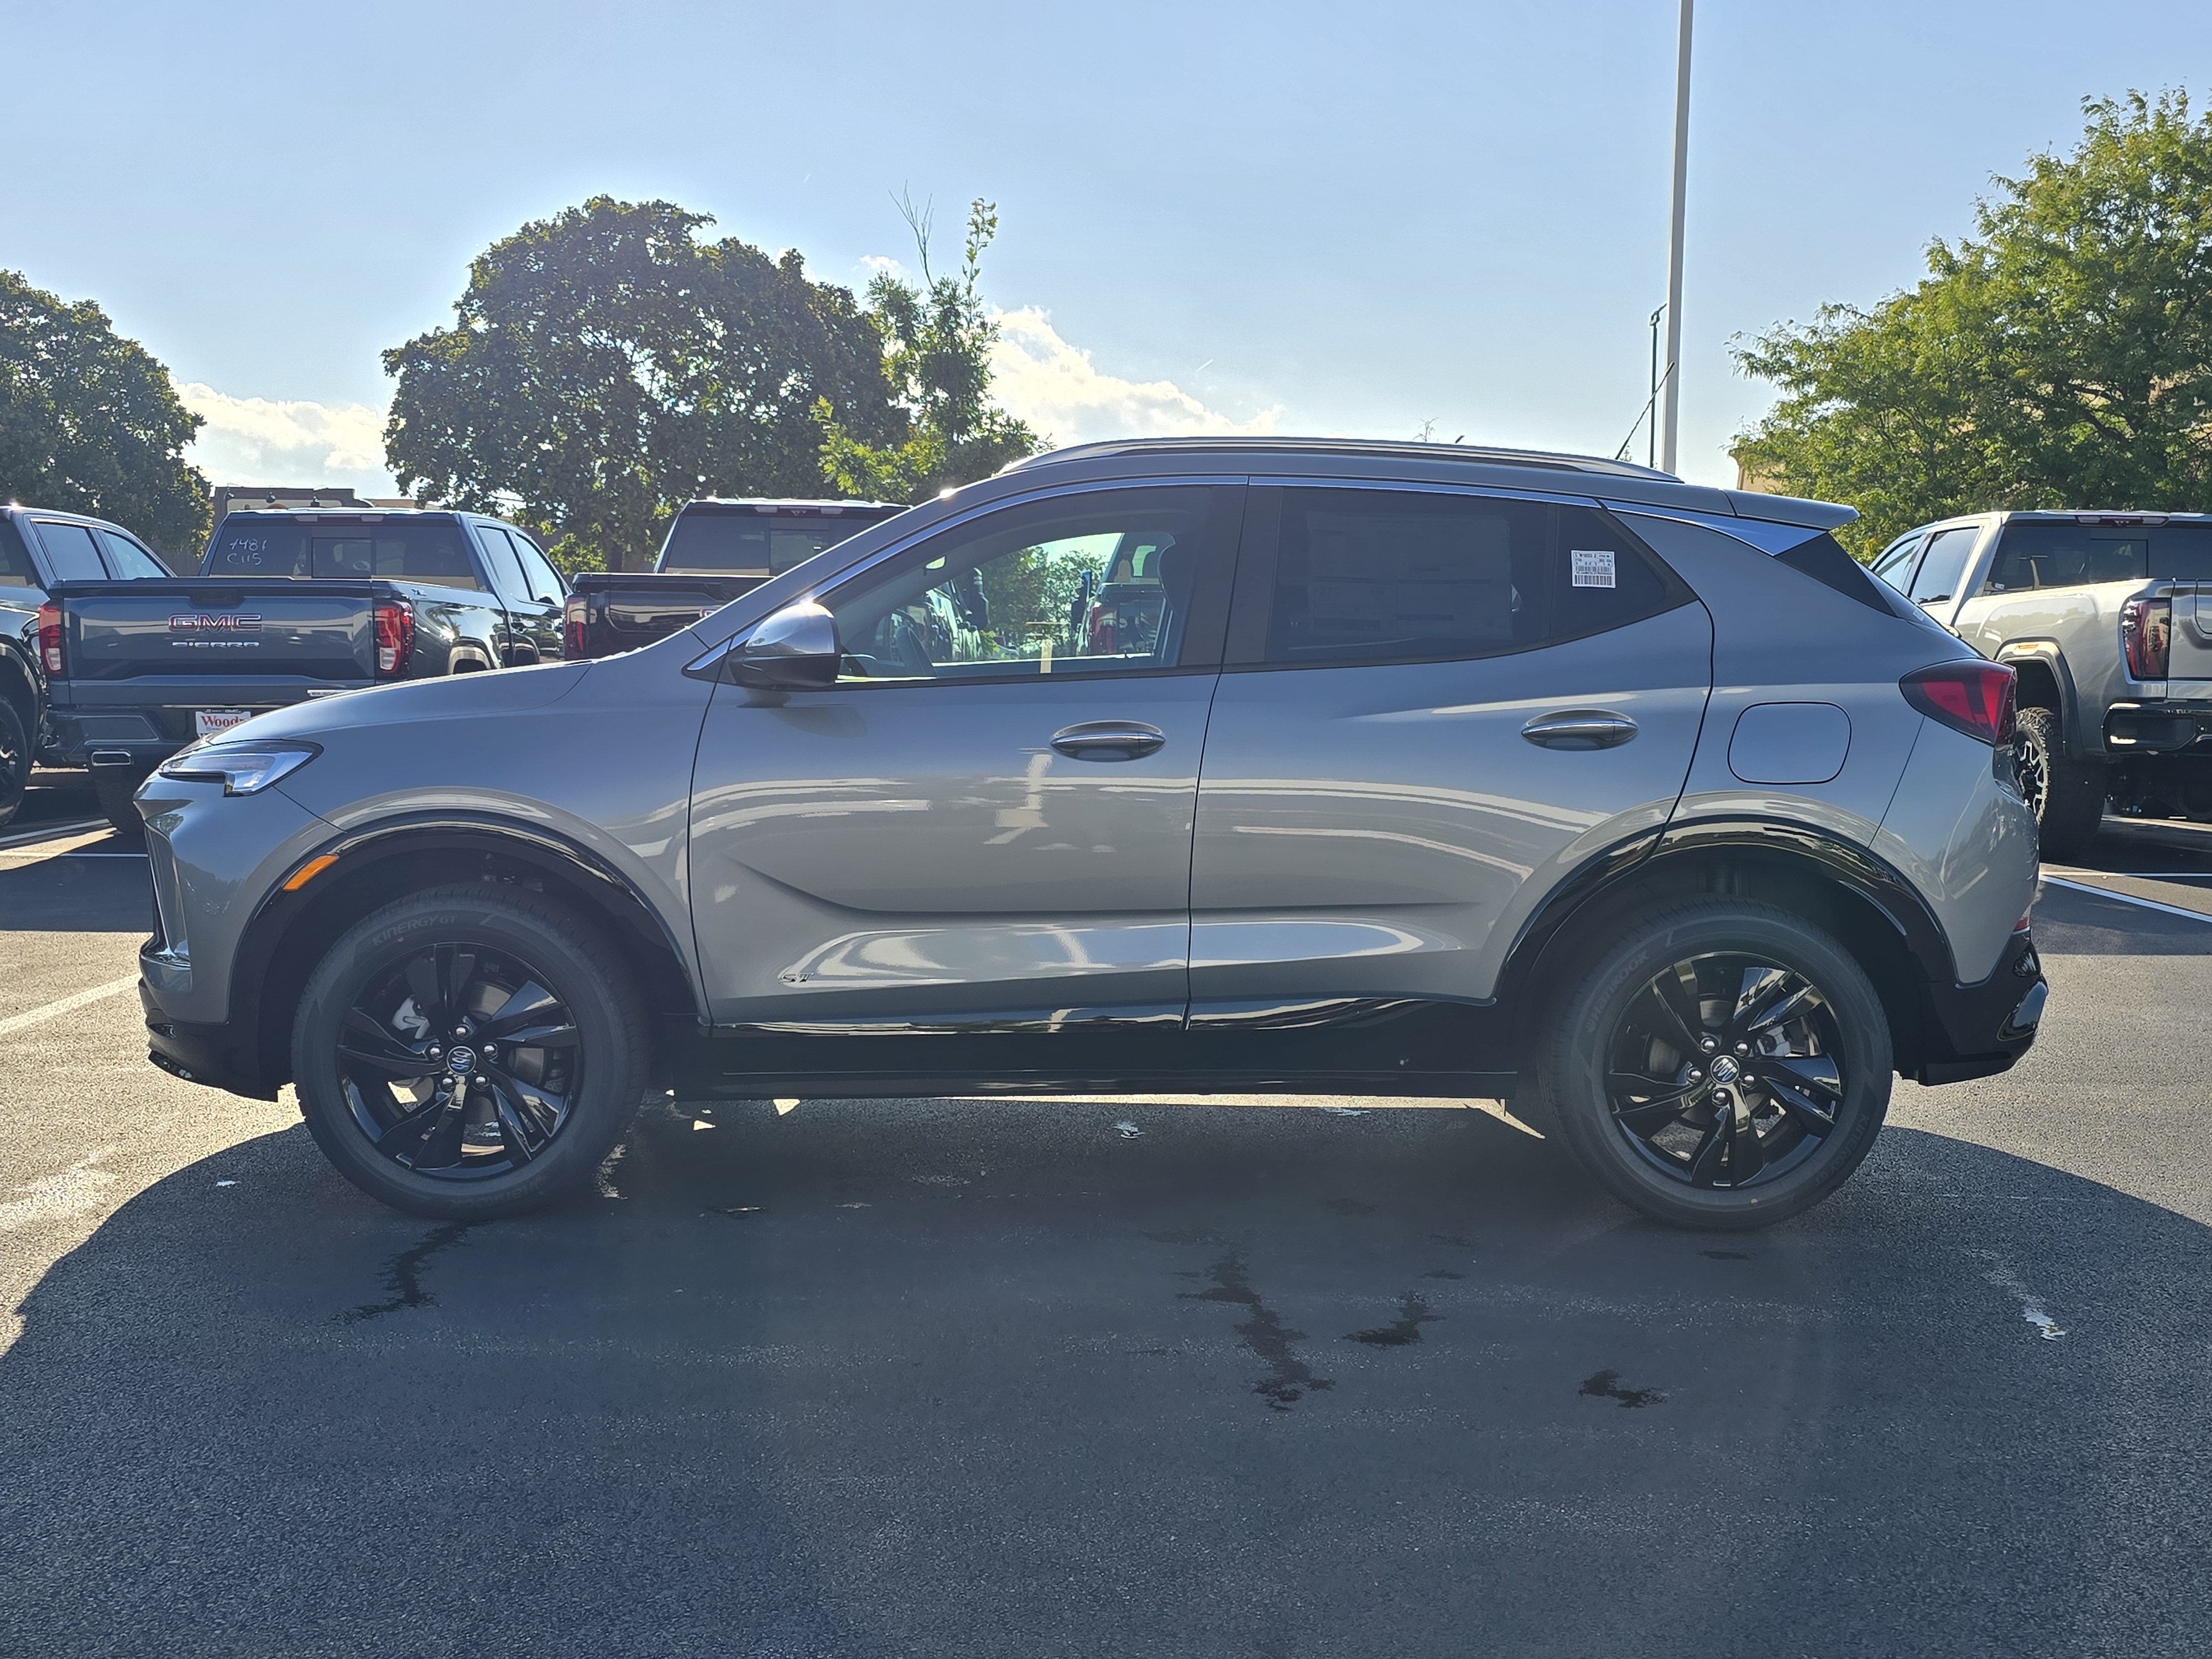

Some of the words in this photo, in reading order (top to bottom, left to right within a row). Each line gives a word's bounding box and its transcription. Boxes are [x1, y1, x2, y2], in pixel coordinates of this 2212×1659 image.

[169, 614, 262, 633] GMC
[373, 914, 440, 946] KINERGY
[778, 973, 815, 983] ST
